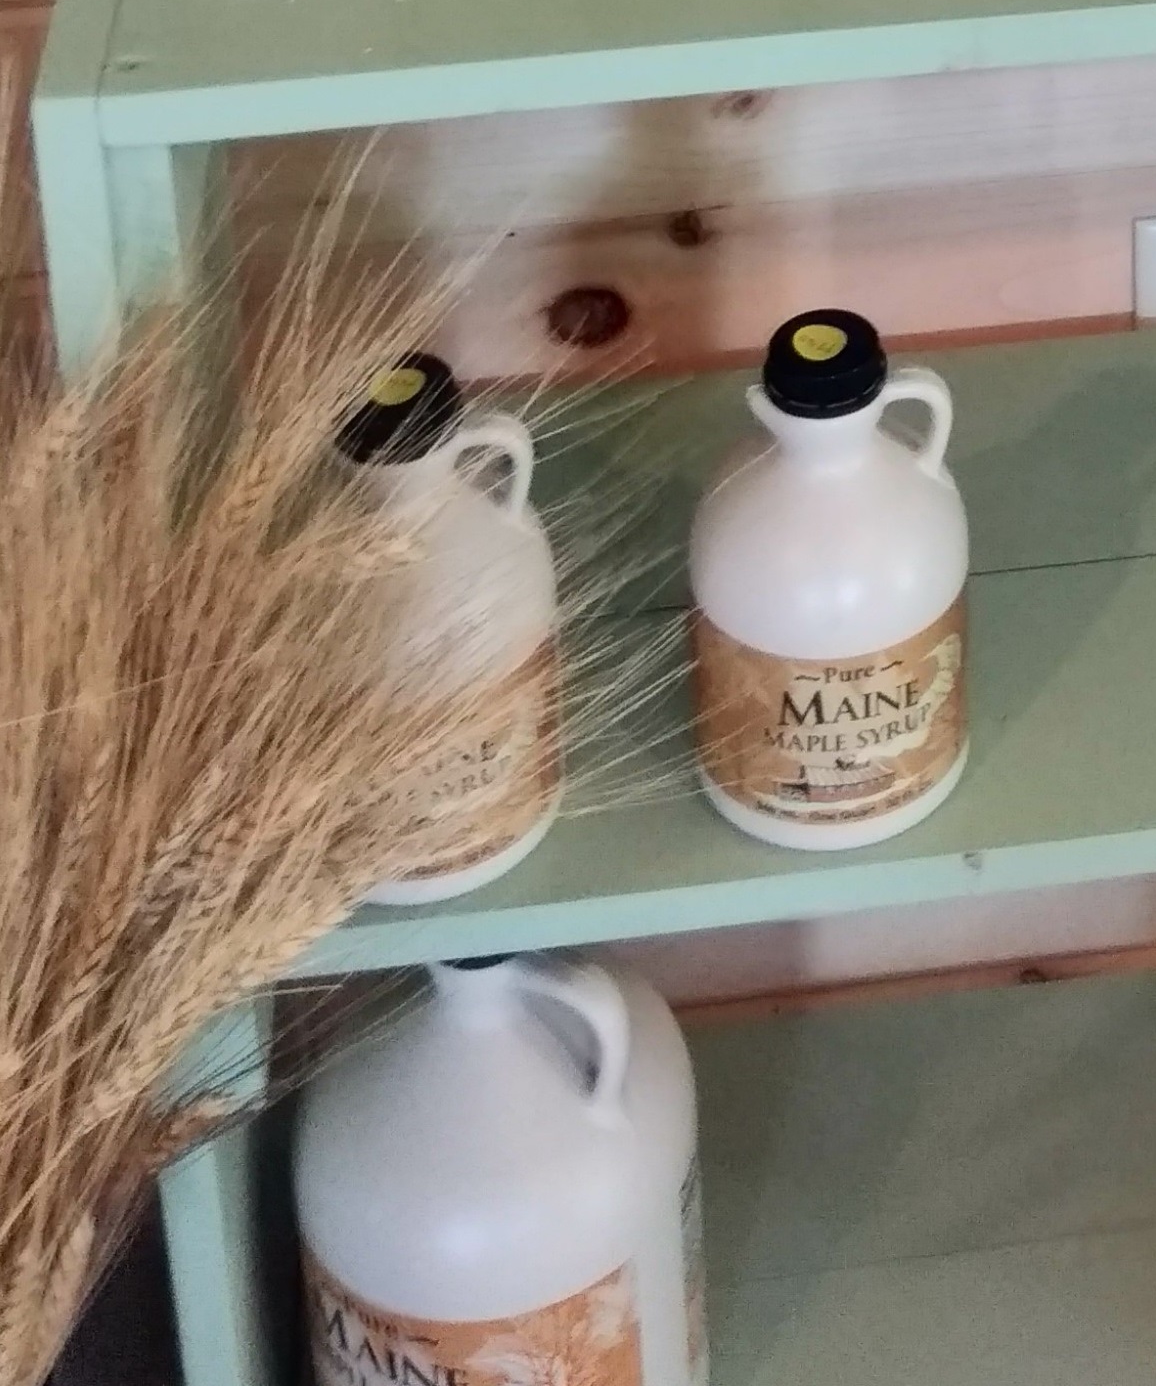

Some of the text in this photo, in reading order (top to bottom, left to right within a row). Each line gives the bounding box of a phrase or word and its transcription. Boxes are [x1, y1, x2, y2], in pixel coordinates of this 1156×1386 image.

[824, 665, 876, 684] Pure
[777, 678, 921, 726] MAINE
[763, 702, 932, 752] MAPLE SYRUP
